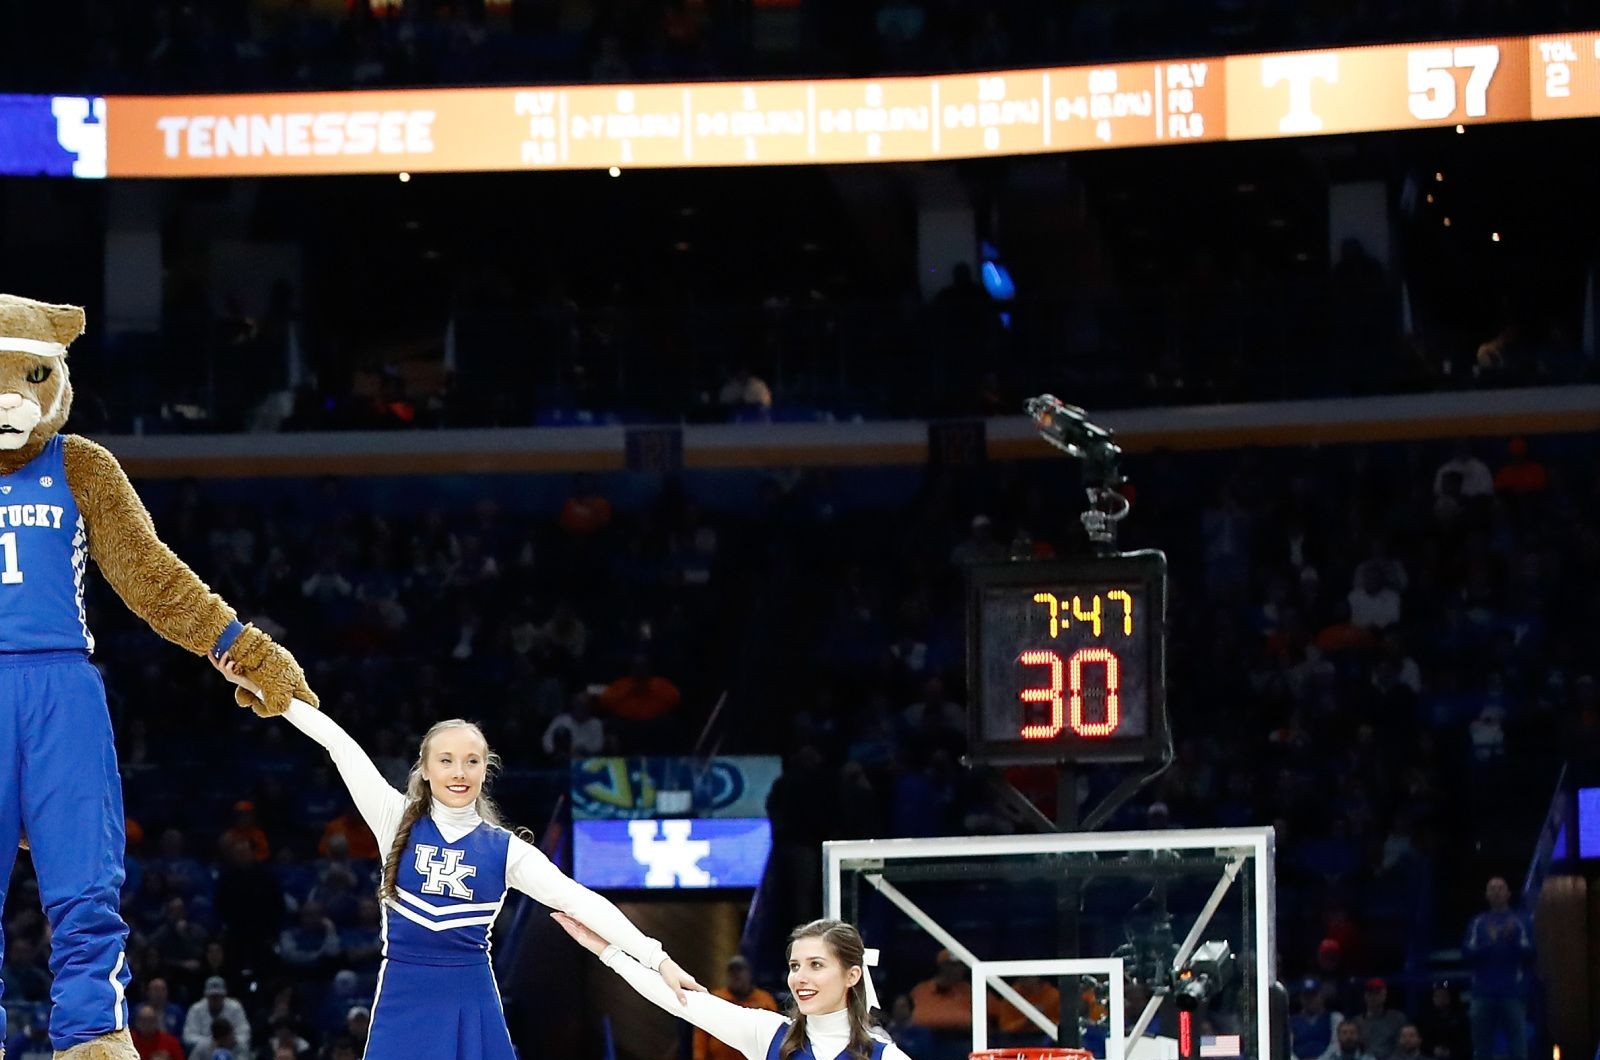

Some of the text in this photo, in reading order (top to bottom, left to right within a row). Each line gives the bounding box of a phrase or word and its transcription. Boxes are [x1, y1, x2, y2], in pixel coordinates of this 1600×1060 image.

[1260, 53, 1340, 132] T
[1407, 44, 1500, 121] 57
[1545, 63, 1571, 98] 2
[157, 109, 436, 158] TENNESSEE
[0, 532, 24, 584] 1
[1033, 590, 1132, 638] 7:47
[1019, 648, 1120, 739] 30
[415, 844, 477, 901] UK
[628, 820, 711, 888] UK
